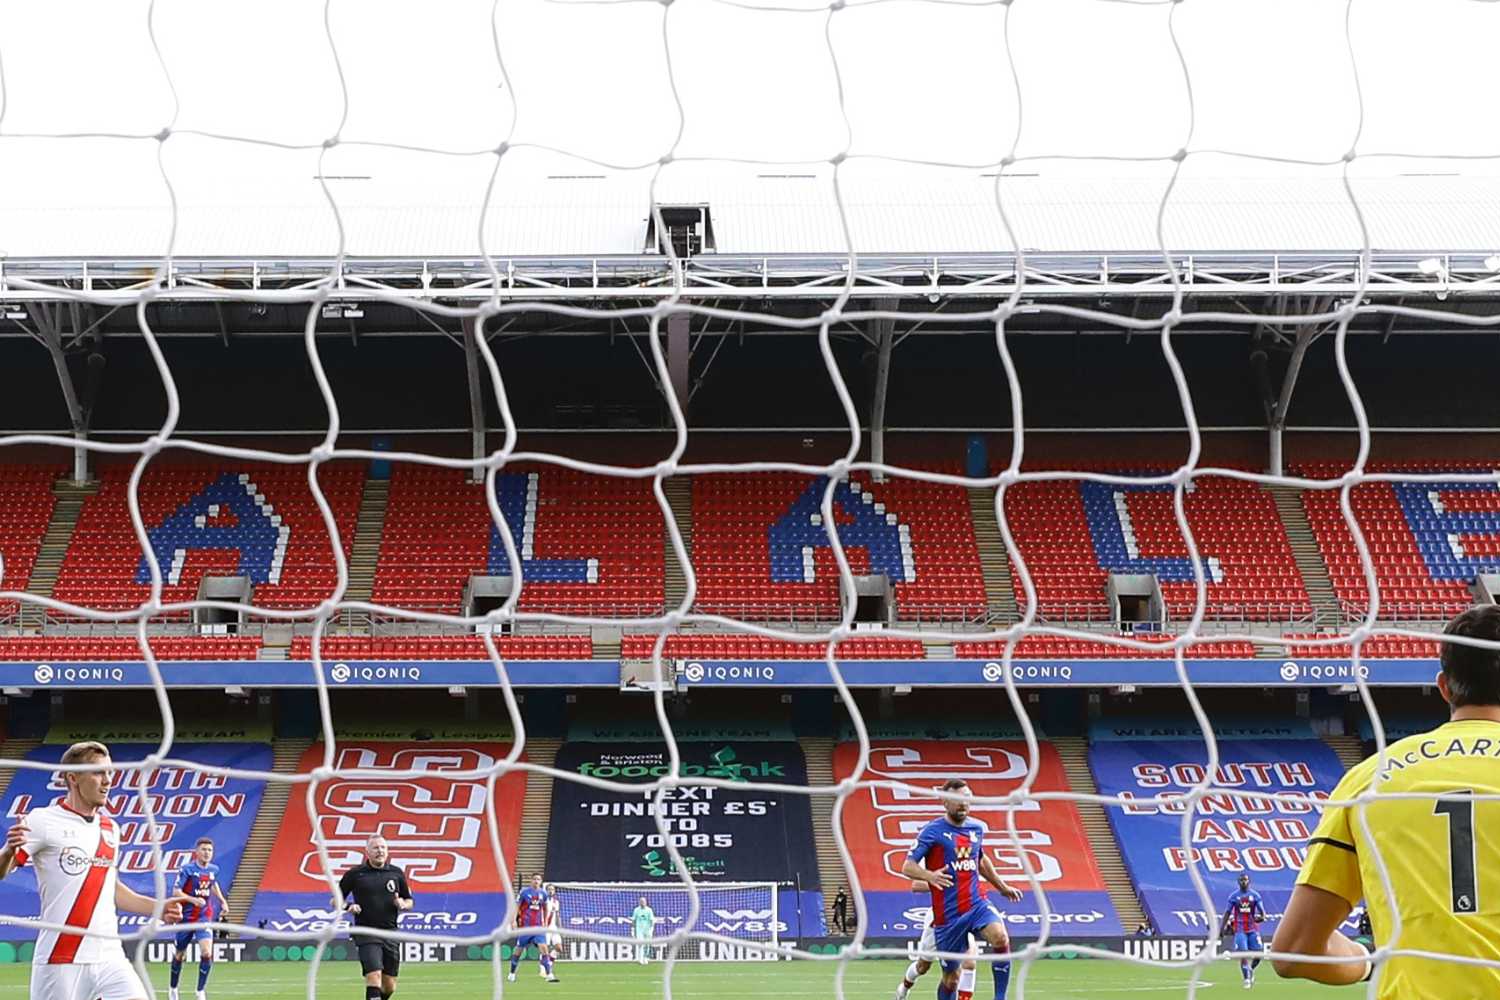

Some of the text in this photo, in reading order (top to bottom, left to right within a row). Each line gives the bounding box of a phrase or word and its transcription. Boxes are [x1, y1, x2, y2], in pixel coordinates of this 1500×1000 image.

[56, 666, 124, 681] IQONIQ
[354, 666, 421, 681] IQONIQ
[706, 665, 775, 680] IQONIQ
[1003, 665, 1072, 680] QONIQ
[1302, 664, 1370, 679] IQONIQ
[144, 731, 187, 739] OE
[1191, 729, 1234, 737] OE
[577, 761, 785, 777] foodbank
[1132, 762, 1316, 788] SOUTH
[47, 767, 230, 791] SUTH
[643, 785, 718, 800] TEXT
[6, 793, 246, 817] LNDON
[660, 817, 698, 831] TO
[1192, 818, 1313, 844] AND
[625, 834, 733, 848] 70085
[1162, 846, 1308, 873] PROU
[1433, 789, 1478, 915] 1
[950, 859, 977, 871] W88
[570, 916, 682, 925] STANEY
[1123, 939, 1222, 959] UNIBET
